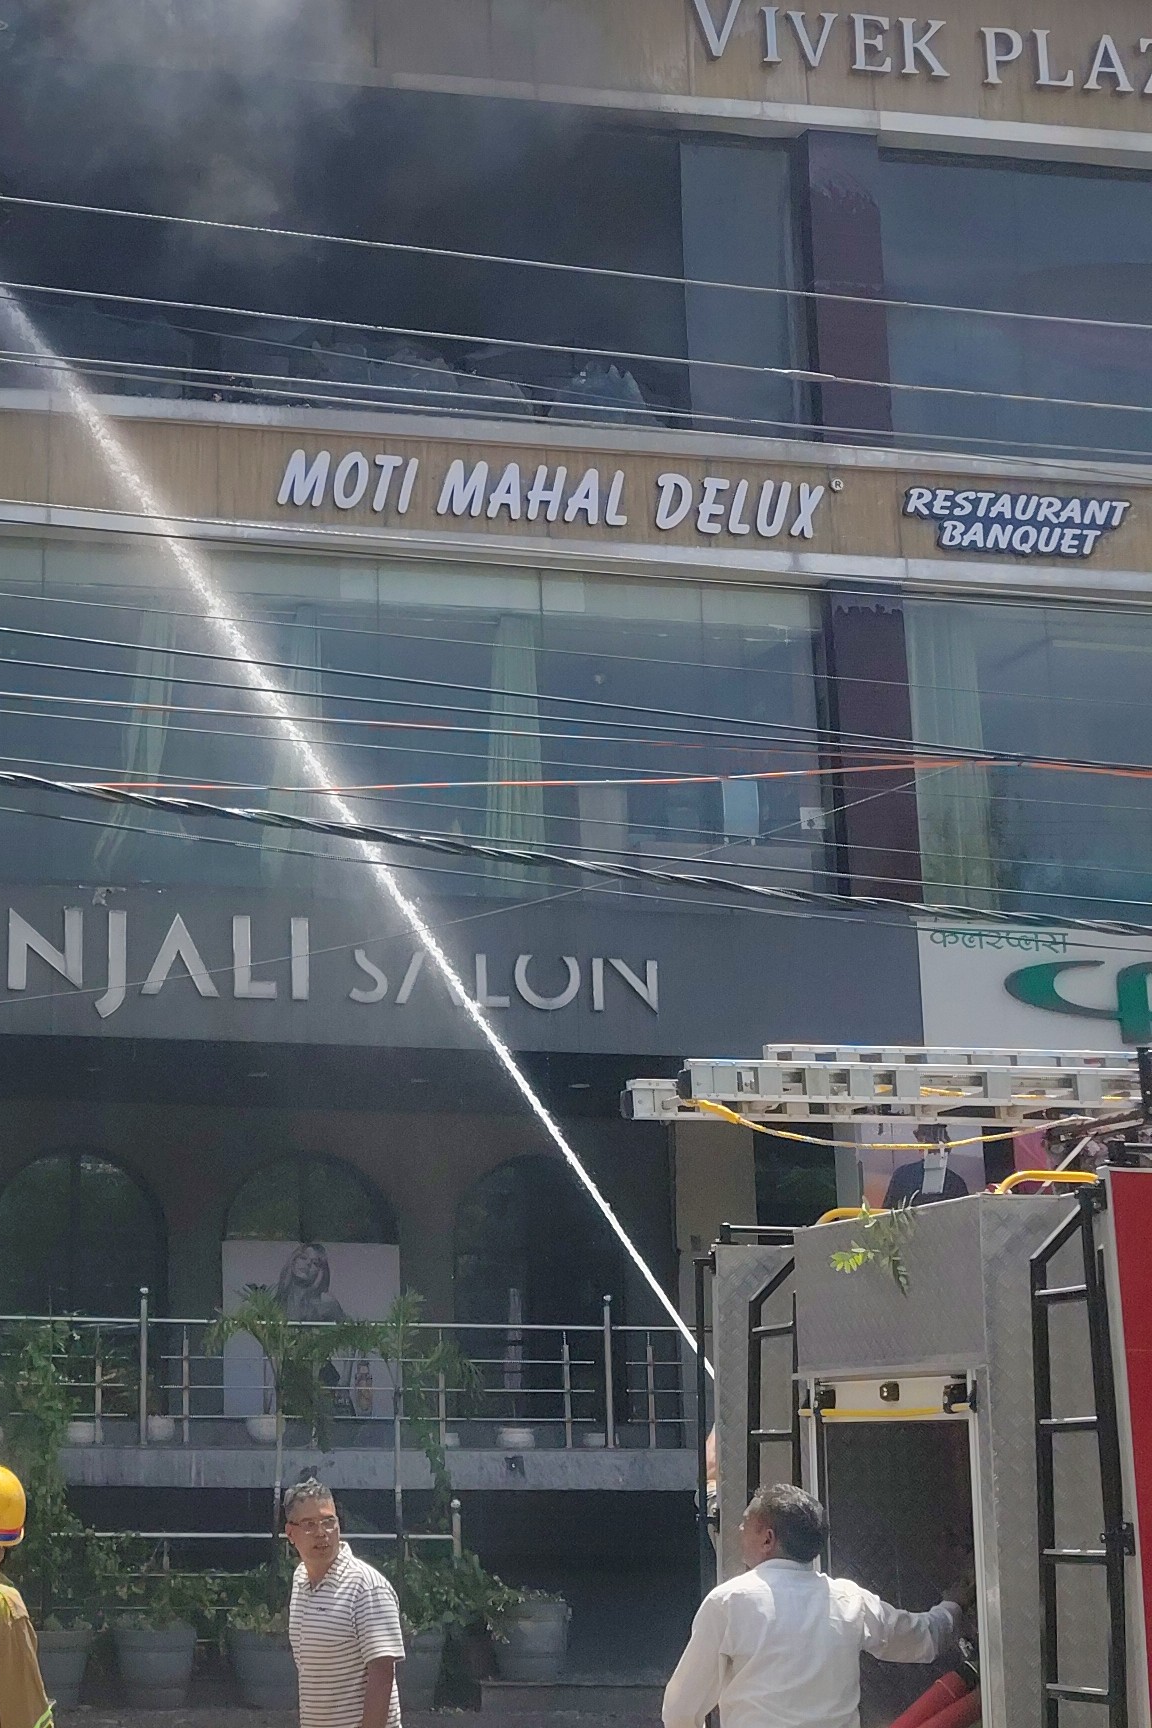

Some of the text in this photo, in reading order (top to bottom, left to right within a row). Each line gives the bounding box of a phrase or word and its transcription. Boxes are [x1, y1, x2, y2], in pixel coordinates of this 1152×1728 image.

[691, 0, 950, 77] VIVEK
[277, 448, 420, 514] MOTI
[435, 459, 628, 527] MAHAL
[904, 486, 1131, 529] RESTAURANT
[939, 518, 1100, 556] BANQUET
[349, 947, 660, 1015] SALON
